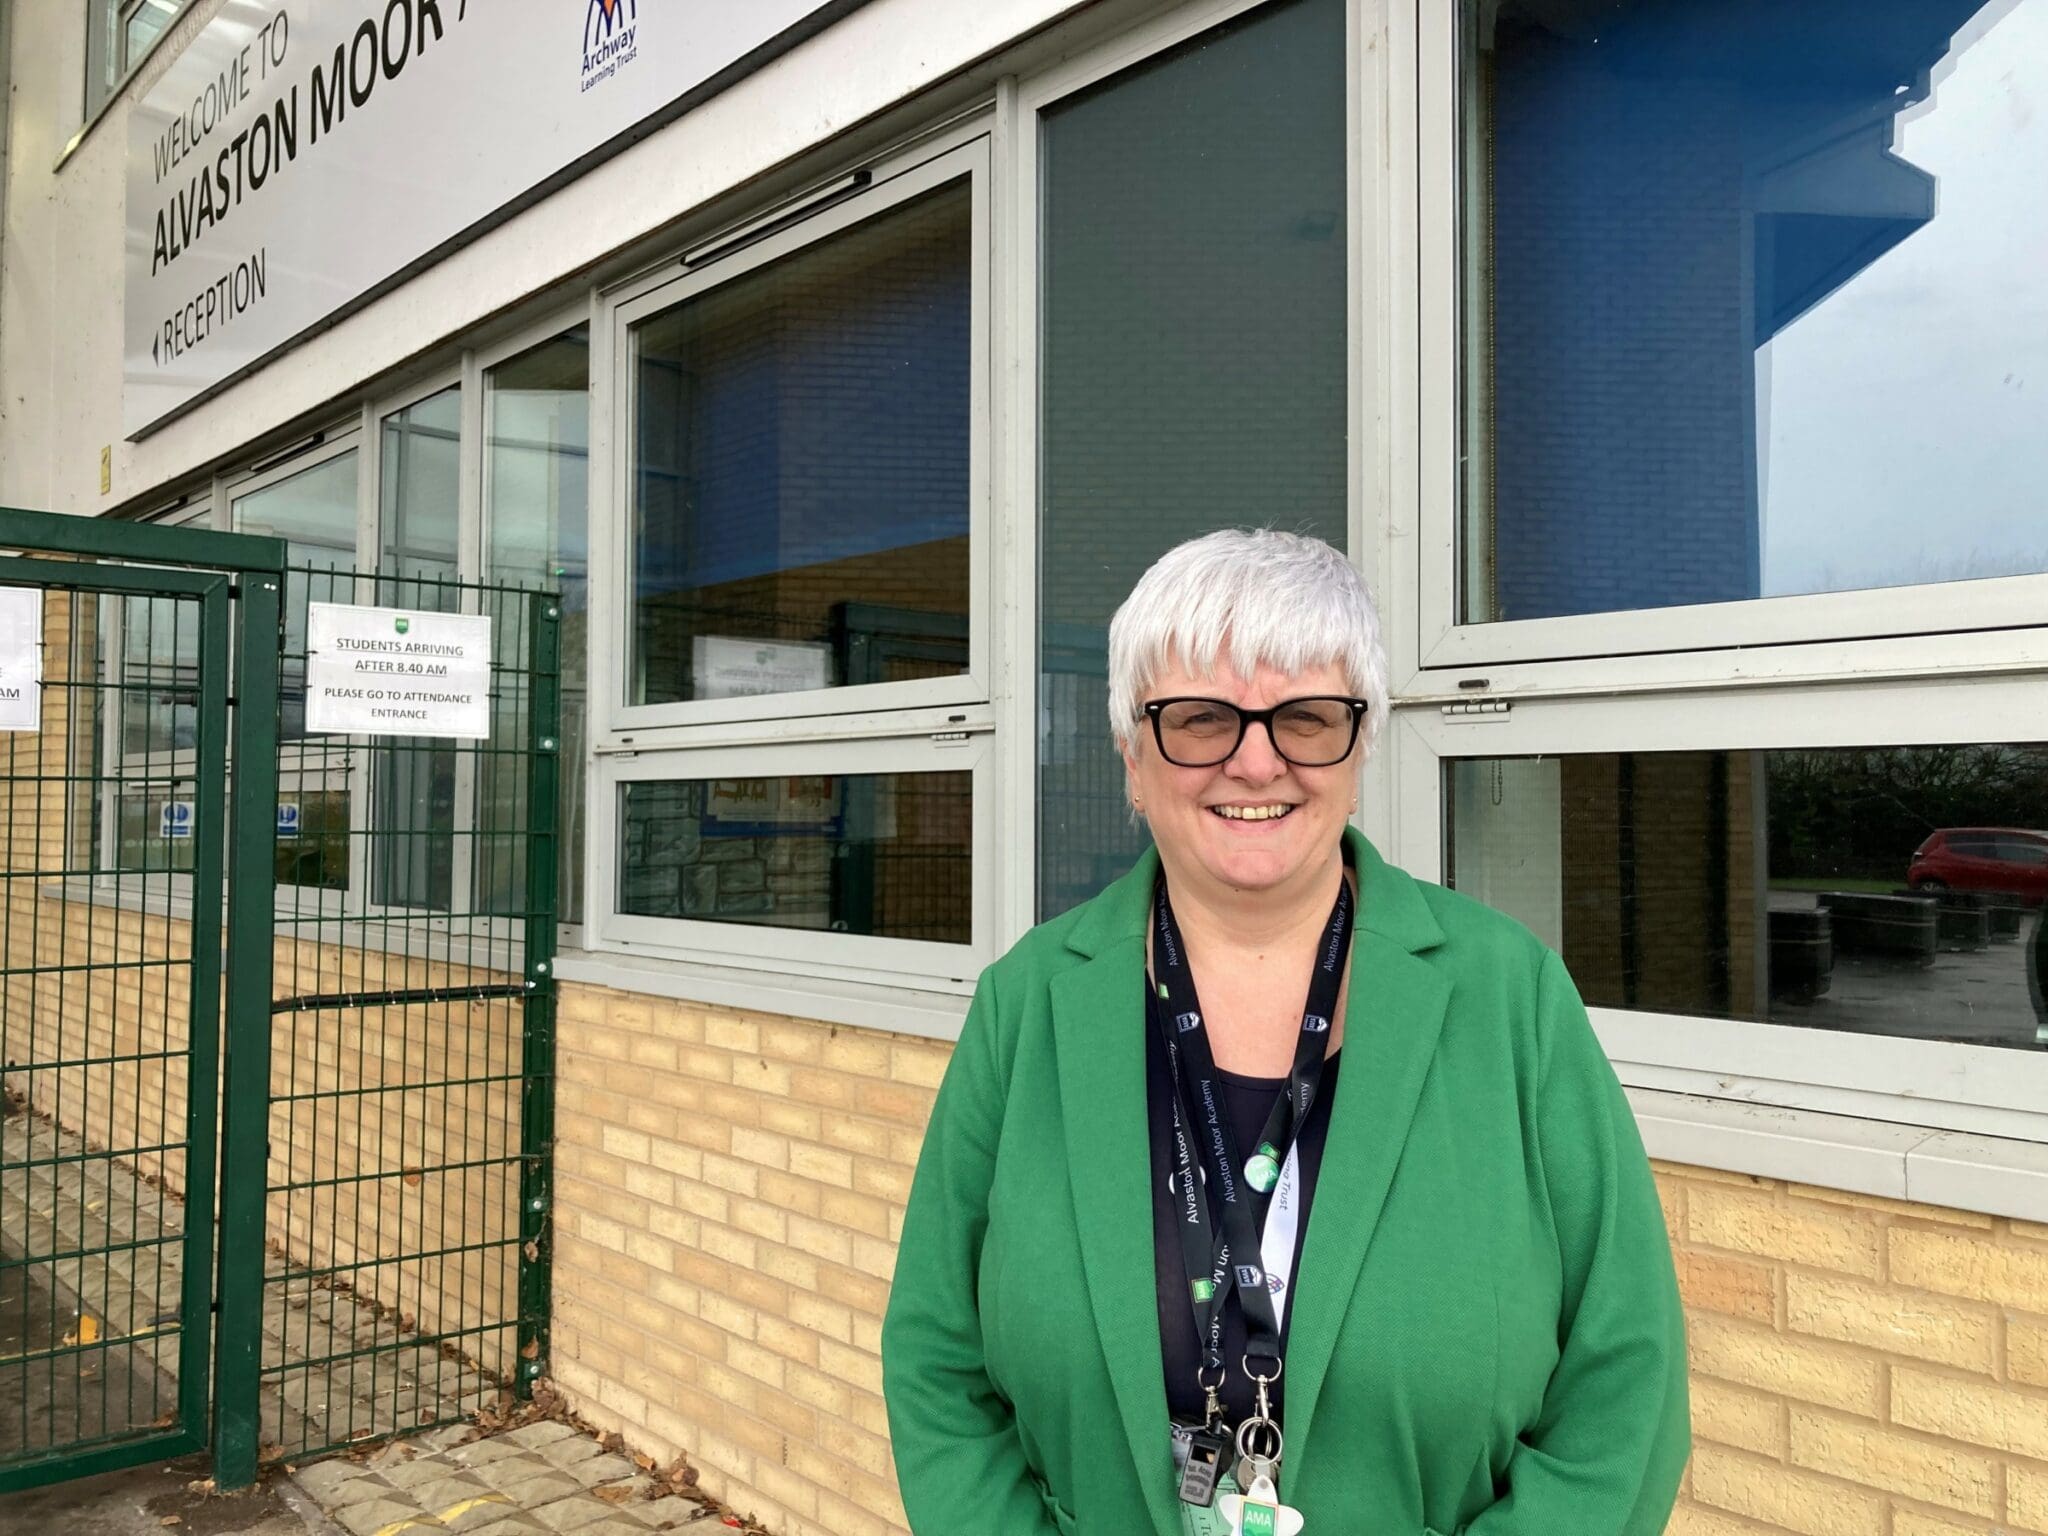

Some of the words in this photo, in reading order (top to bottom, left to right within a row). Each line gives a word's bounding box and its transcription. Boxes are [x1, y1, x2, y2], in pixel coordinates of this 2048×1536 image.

[581, 25, 637, 77] Archway
[581, 62, 616, 93] Learning
[616, 46, 637, 69] Trust
[154, 44, 250, 184] WELCOME
[258, 9, 288, 80] TO
[152, 84, 297, 277] ALVASTON
[310, 0, 444, 145] MOOR
[164, 247, 265, 365] RECEPTION
[336, 637, 402, 652] STUDENTS
[404, 642, 464, 657] ARRIVING
[355, 660, 394, 672] AFTER
[397, 662, 423, 674] 8.40
[426, 665, 448, 675] AM
[324, 687, 364, 699] PLEASE
[367, 690, 384, 699] GO
[386, 691, 401, 700] TO
[404, 692, 473, 704] ATTENDANCE
[371, 708, 429, 719] ENTRANCE
[1323, 933, 1341, 973] Alvaston
[1332, 910, 1346, 936] Moor
[1201, 1080, 1219, 1125] Academy
[1176, 1131, 1190, 1165] Moor
[1212, 1127, 1225, 1156] Moor
[1219, 1157, 1237, 1203] Alvaston
[1280, 1181, 1291, 1211] Trust
[1245, 1510, 1271, 1527] AMA
